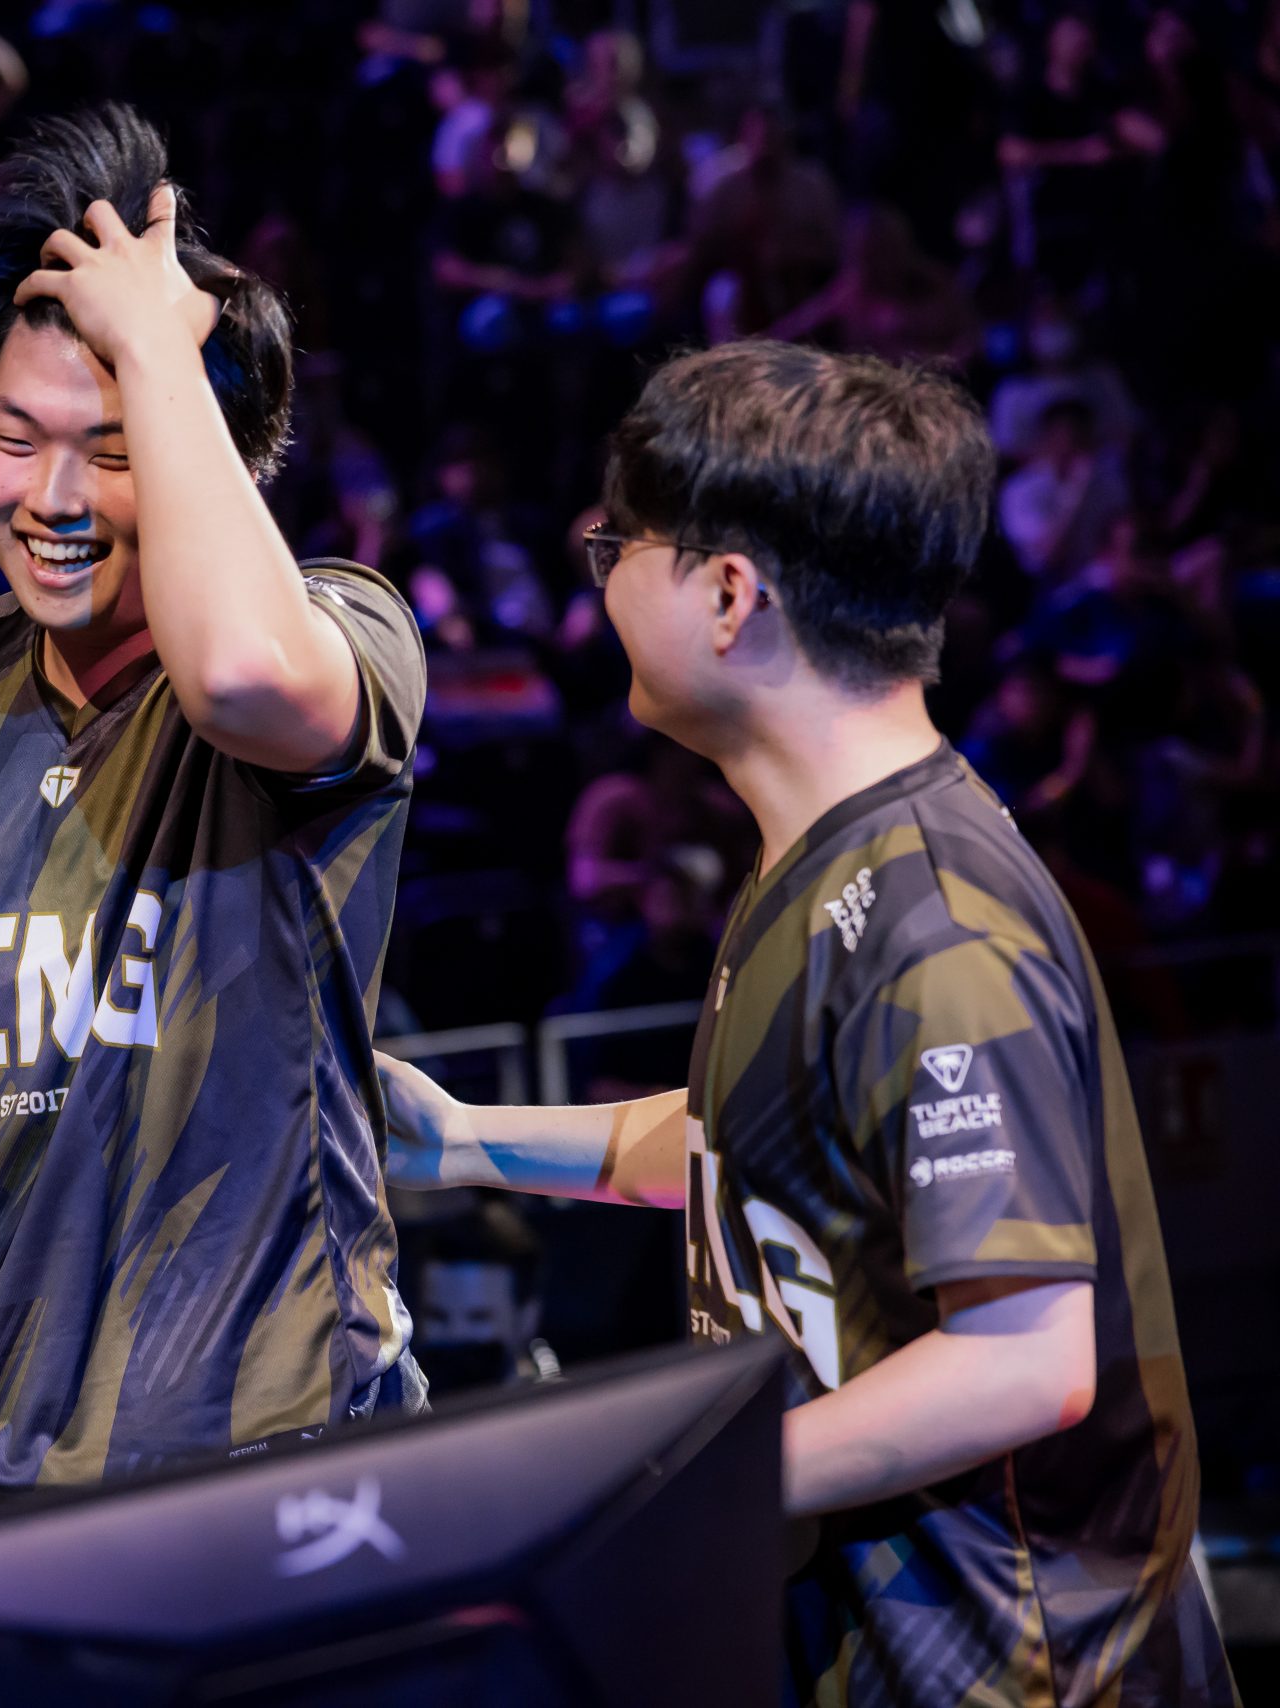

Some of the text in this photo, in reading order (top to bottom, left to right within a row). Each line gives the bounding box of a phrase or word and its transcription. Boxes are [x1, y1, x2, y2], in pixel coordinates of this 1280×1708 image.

[15, 1087, 70, 1115] 2017
[910, 1092, 1002, 1121] TURTLE
[918, 1110, 1002, 1139] BEACH
